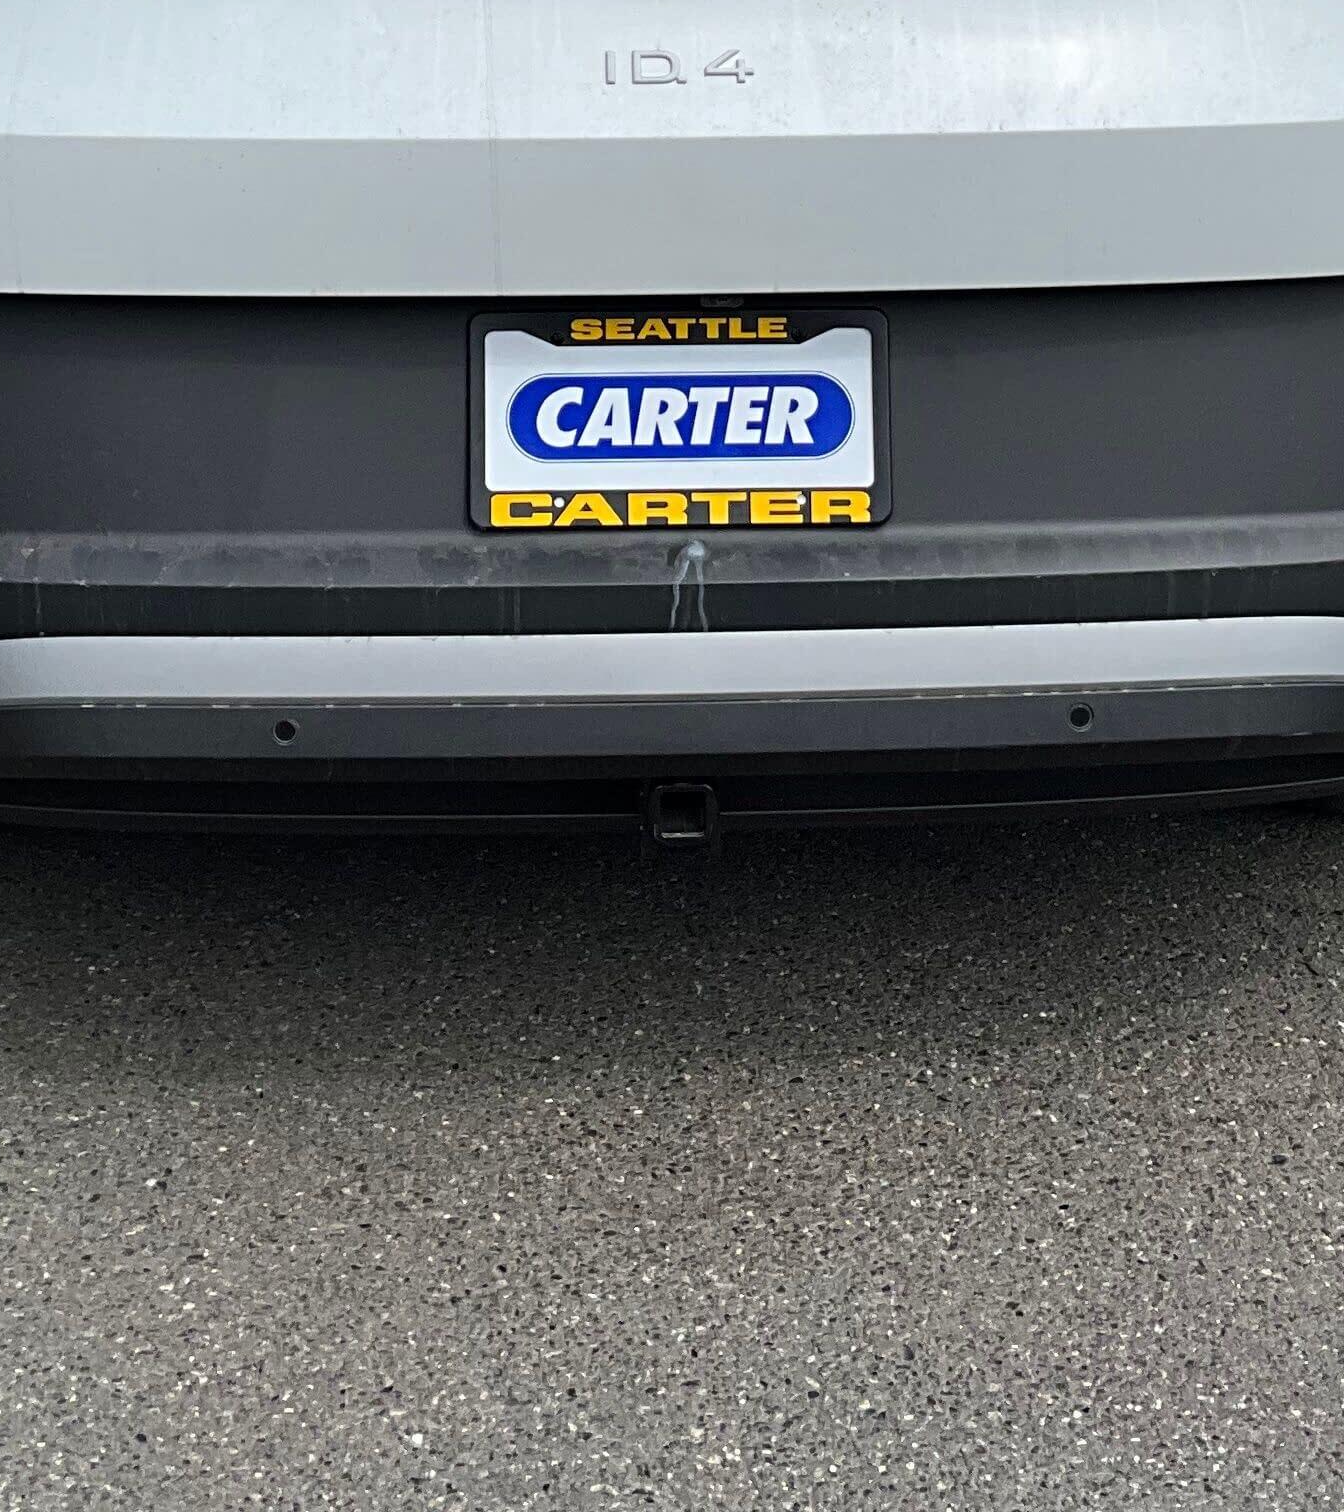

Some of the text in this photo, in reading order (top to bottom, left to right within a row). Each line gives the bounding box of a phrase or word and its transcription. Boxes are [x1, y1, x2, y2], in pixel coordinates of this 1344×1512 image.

[570, 317, 788, 340] SEATTLE
[536, 385, 819, 447] CARTER
[490, 490, 871, 527] CARTER
